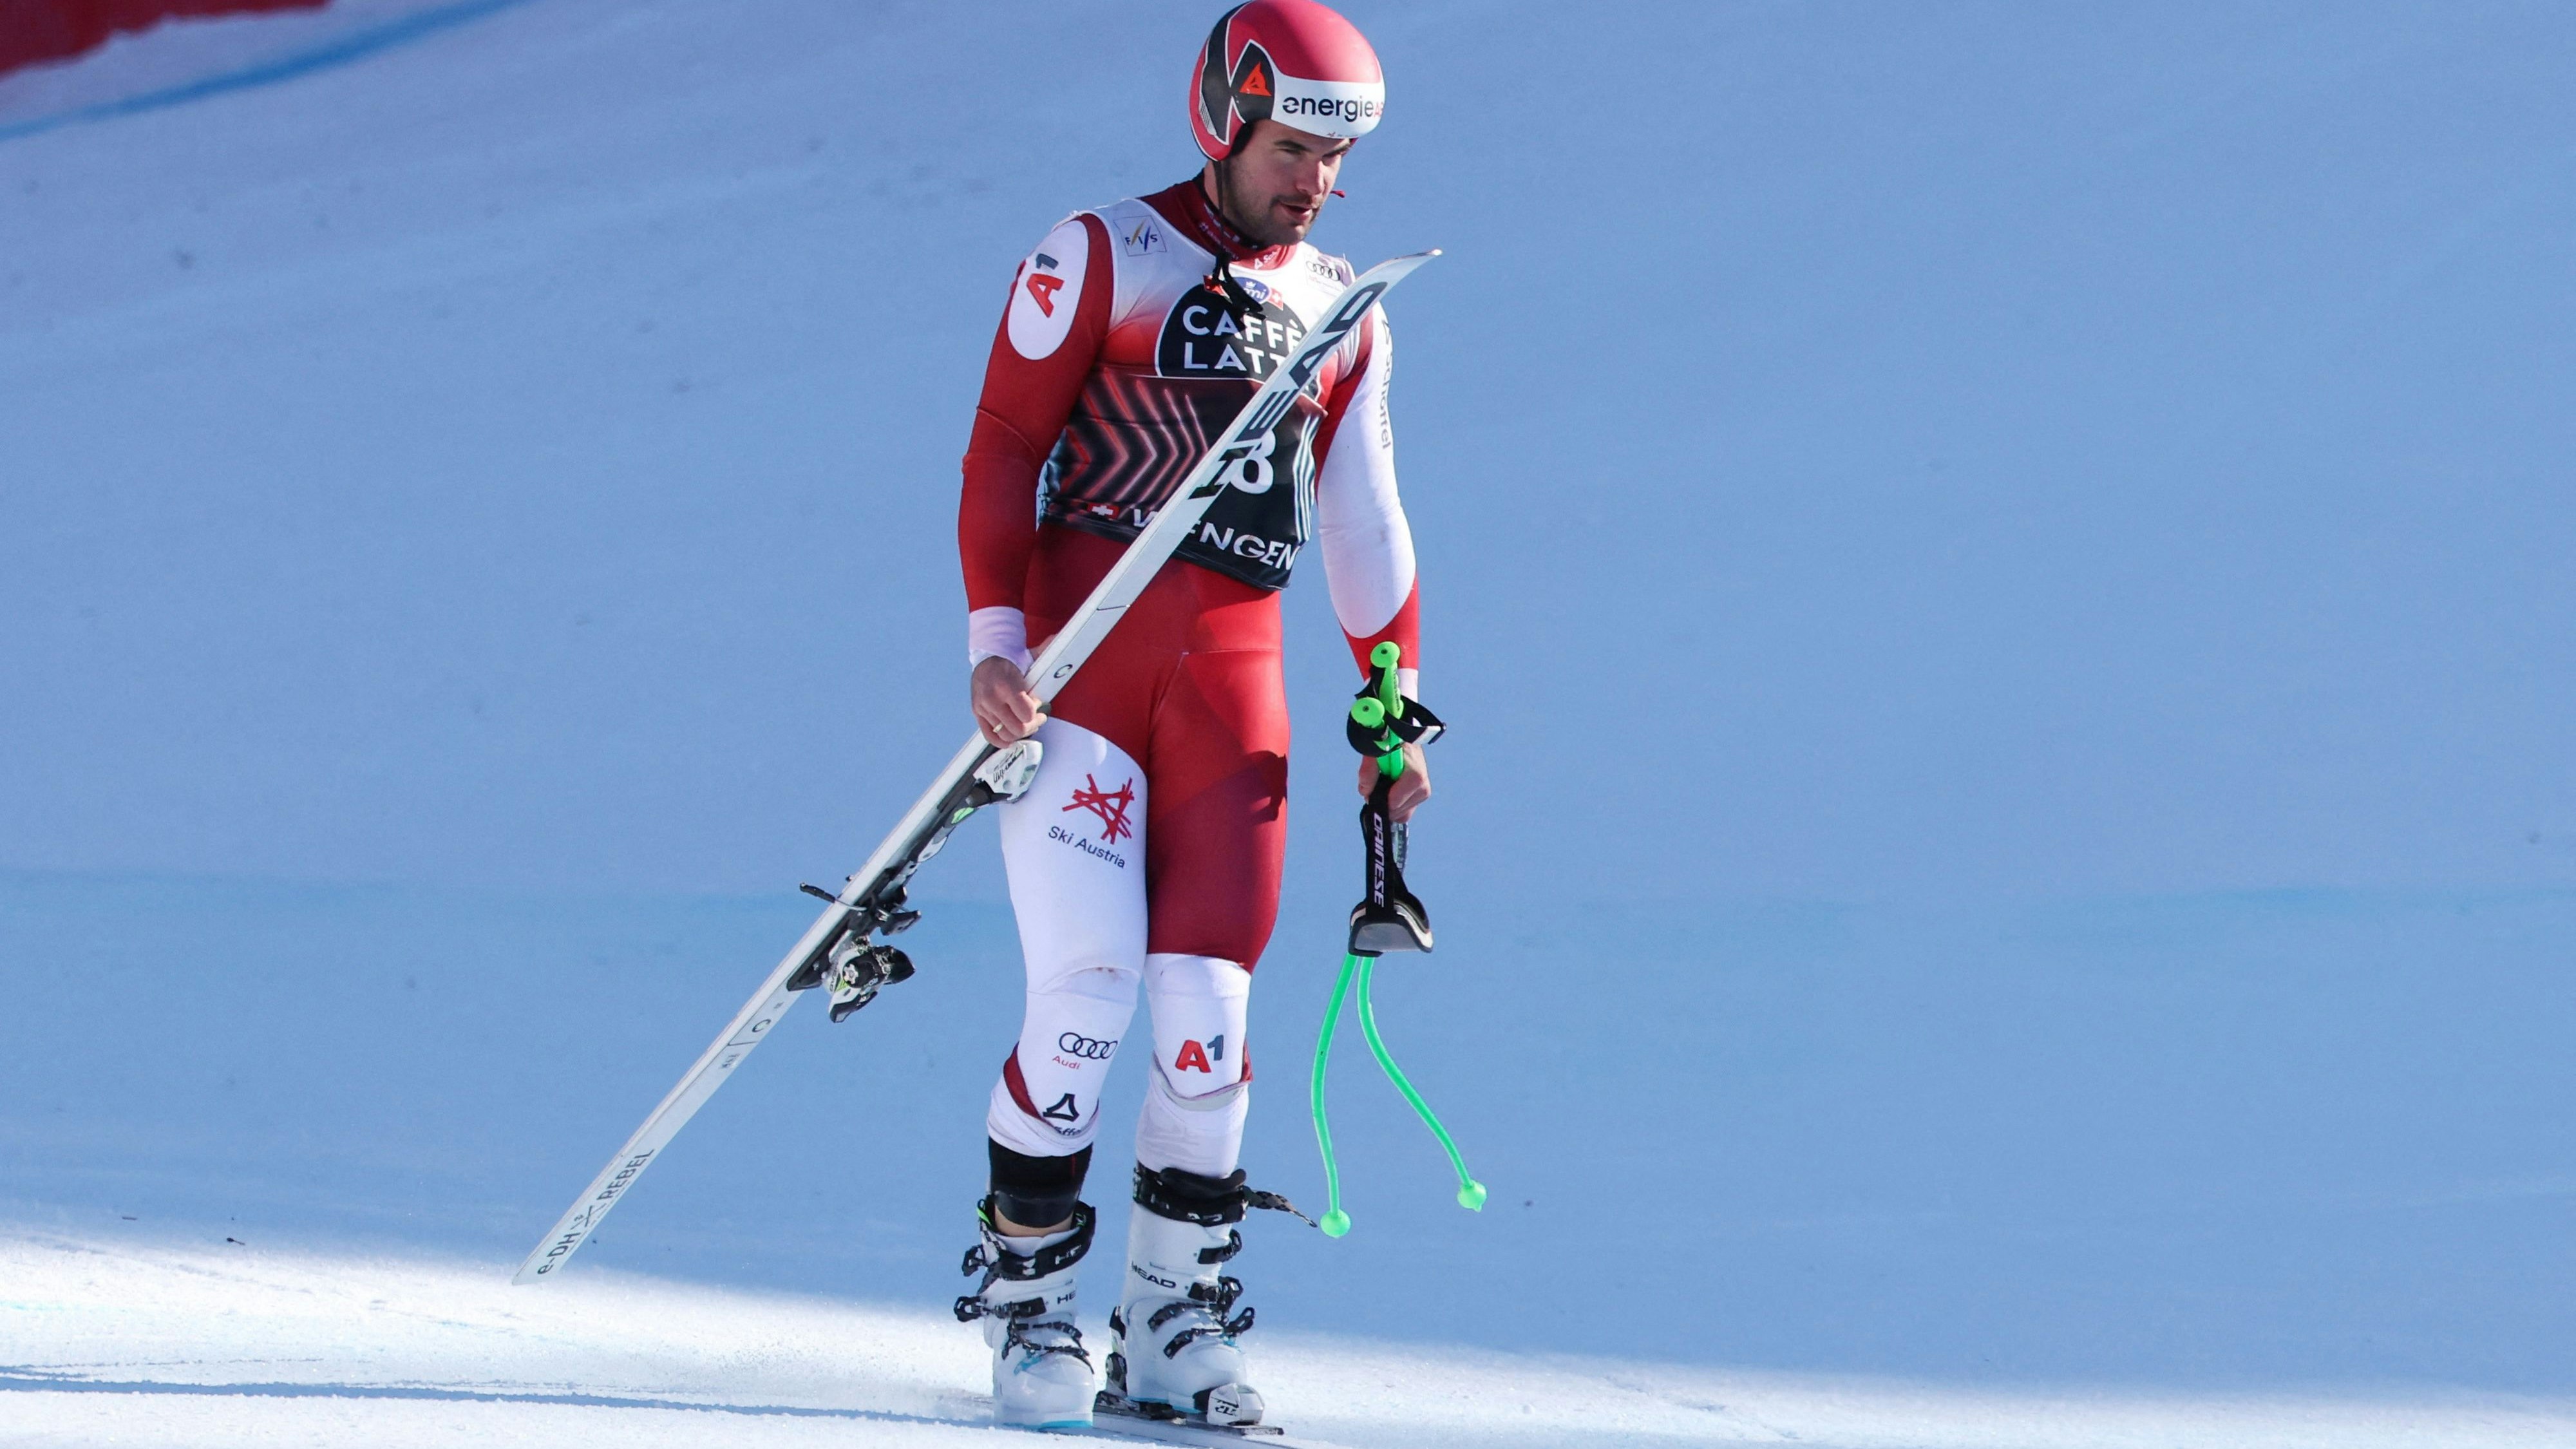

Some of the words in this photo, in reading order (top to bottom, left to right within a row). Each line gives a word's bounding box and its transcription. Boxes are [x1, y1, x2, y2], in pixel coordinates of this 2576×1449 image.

[1027, 253, 1065, 318] A1
[1184, 342, 1285, 375] LATT
[1188, 281, 1388, 500] HEAD
[1048, 826, 1074, 844] Ski
[1074, 838, 1126, 869] Austria
[1373, 812, 1385, 907] DAINESE
[1052, 1055, 1081, 1070] Audi
[1175, 1034, 1224, 1073] A1
